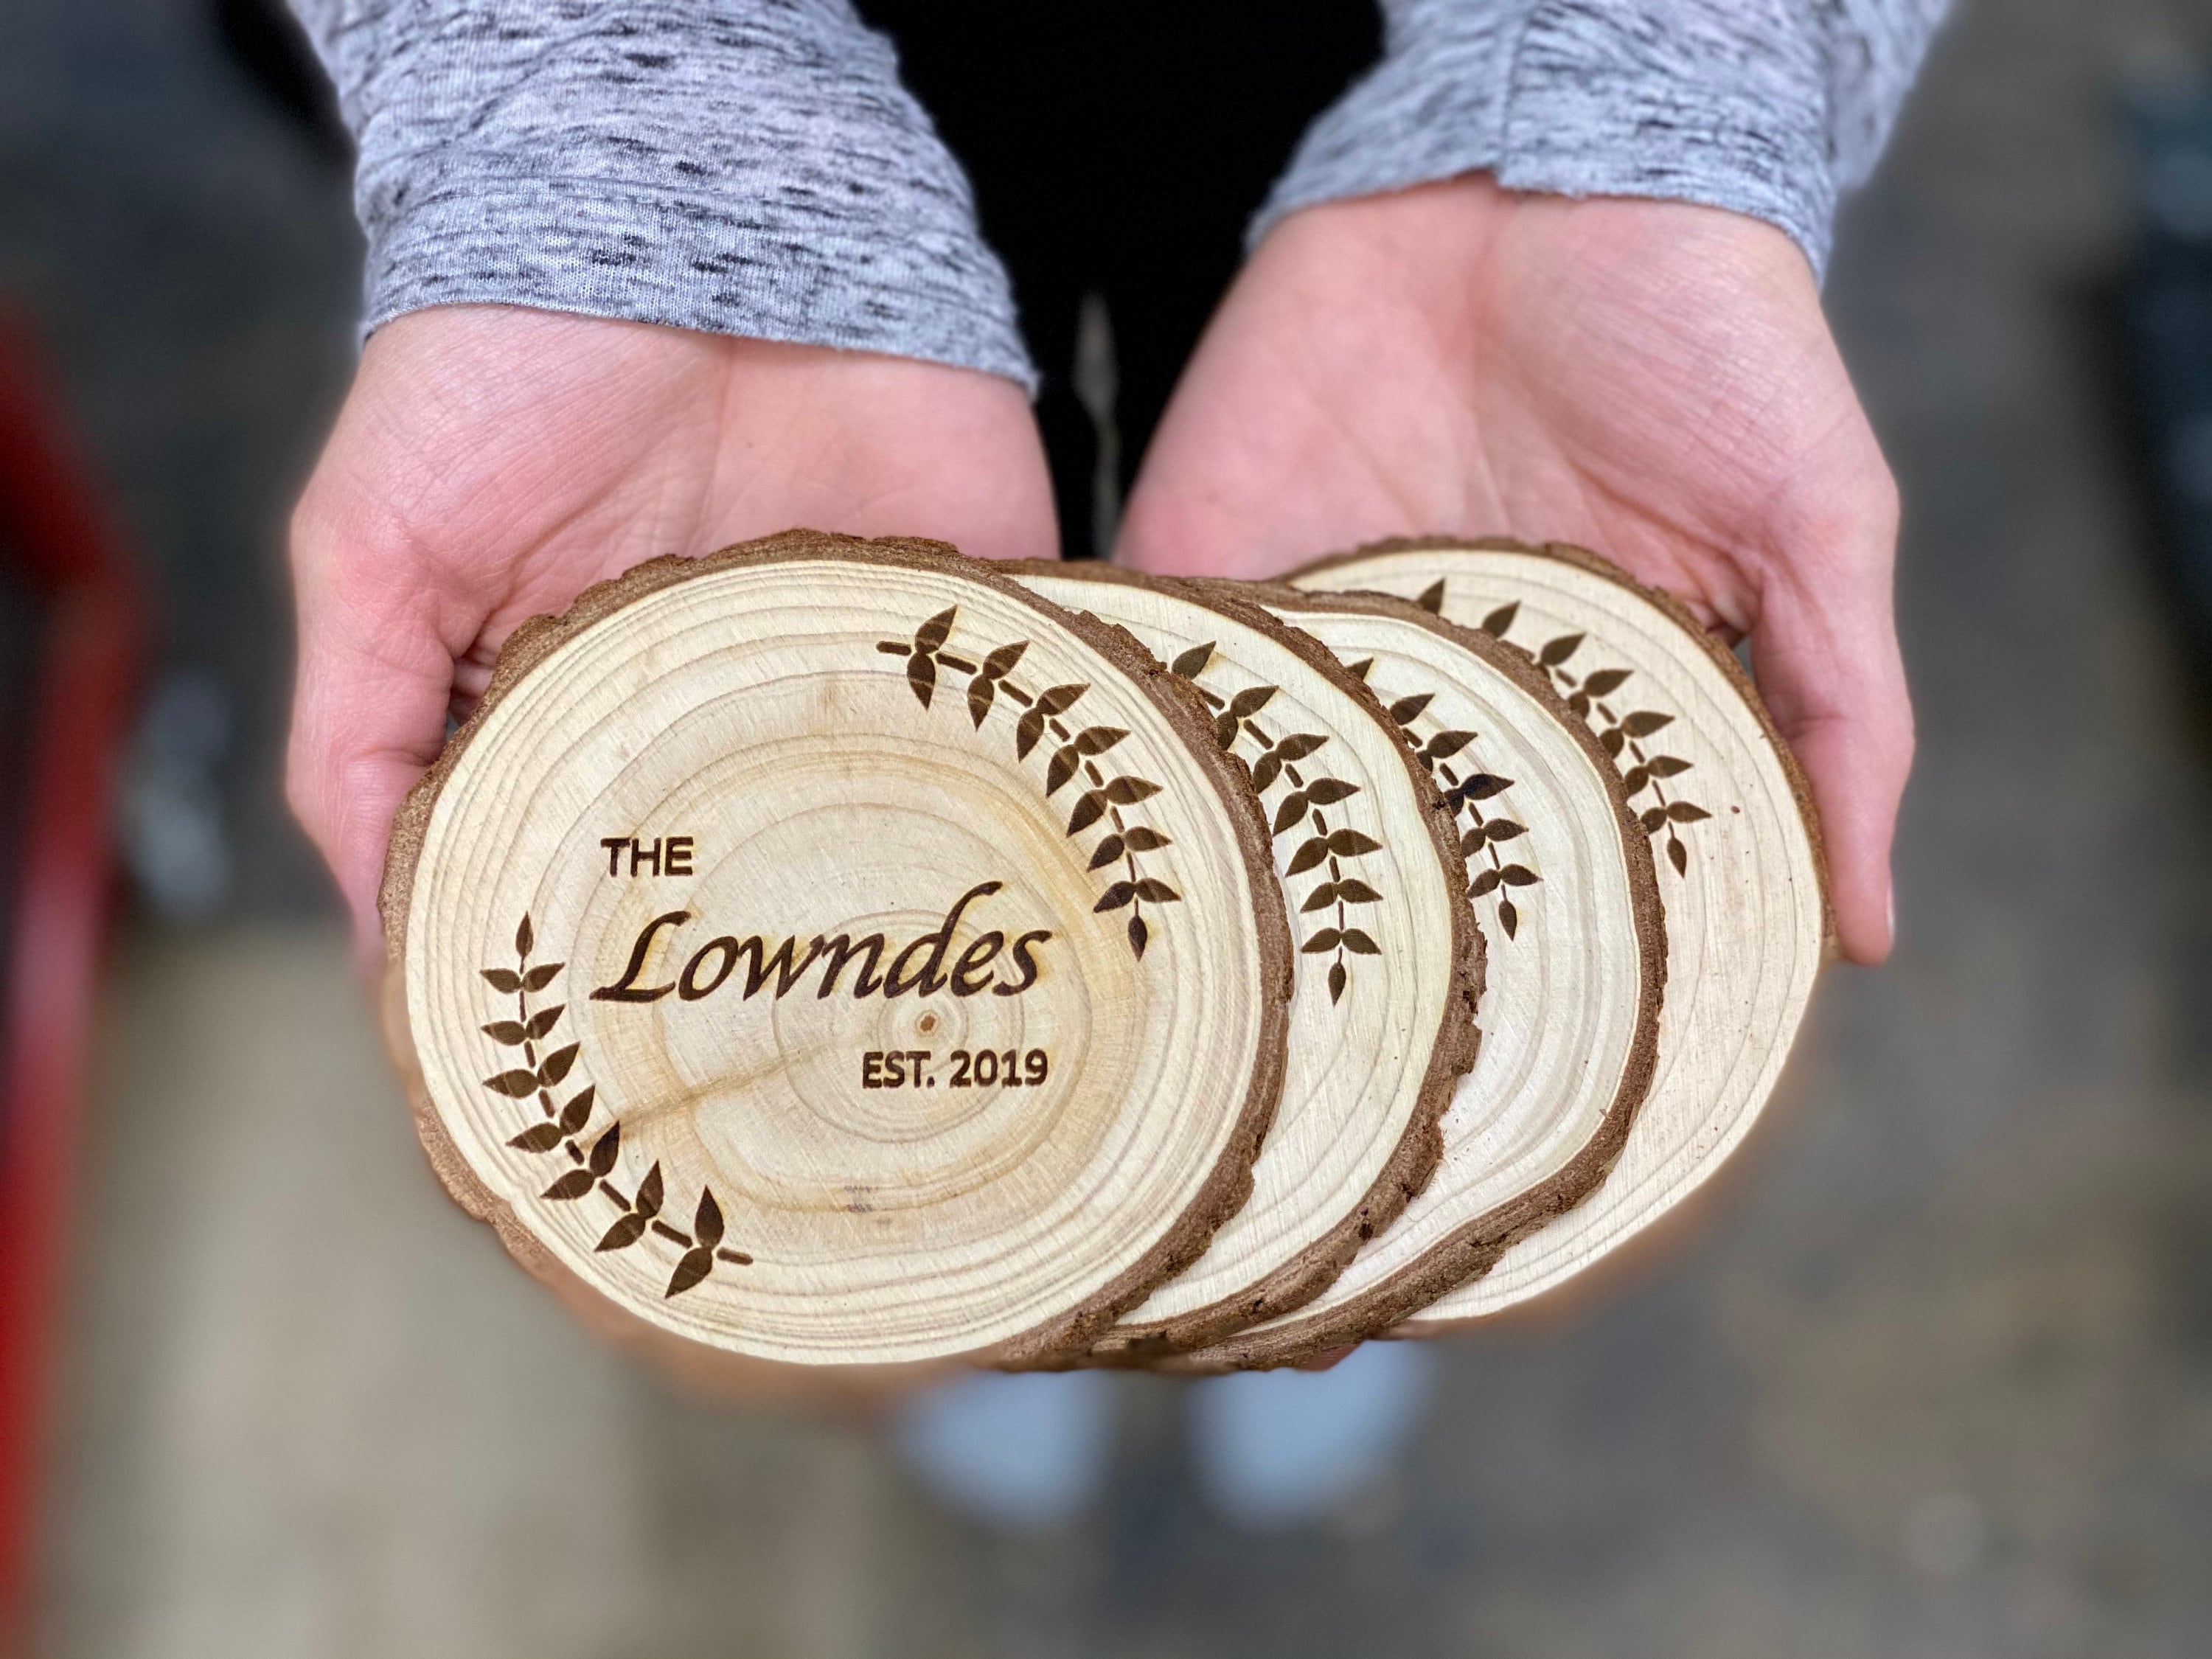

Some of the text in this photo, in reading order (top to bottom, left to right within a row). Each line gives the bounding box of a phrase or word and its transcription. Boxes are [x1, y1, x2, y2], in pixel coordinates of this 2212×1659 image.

[600, 836, 694, 877] THE
[589, 881, 1053, 1004] Lowndes
[862, 1048, 1048, 1089] EST. 2019
